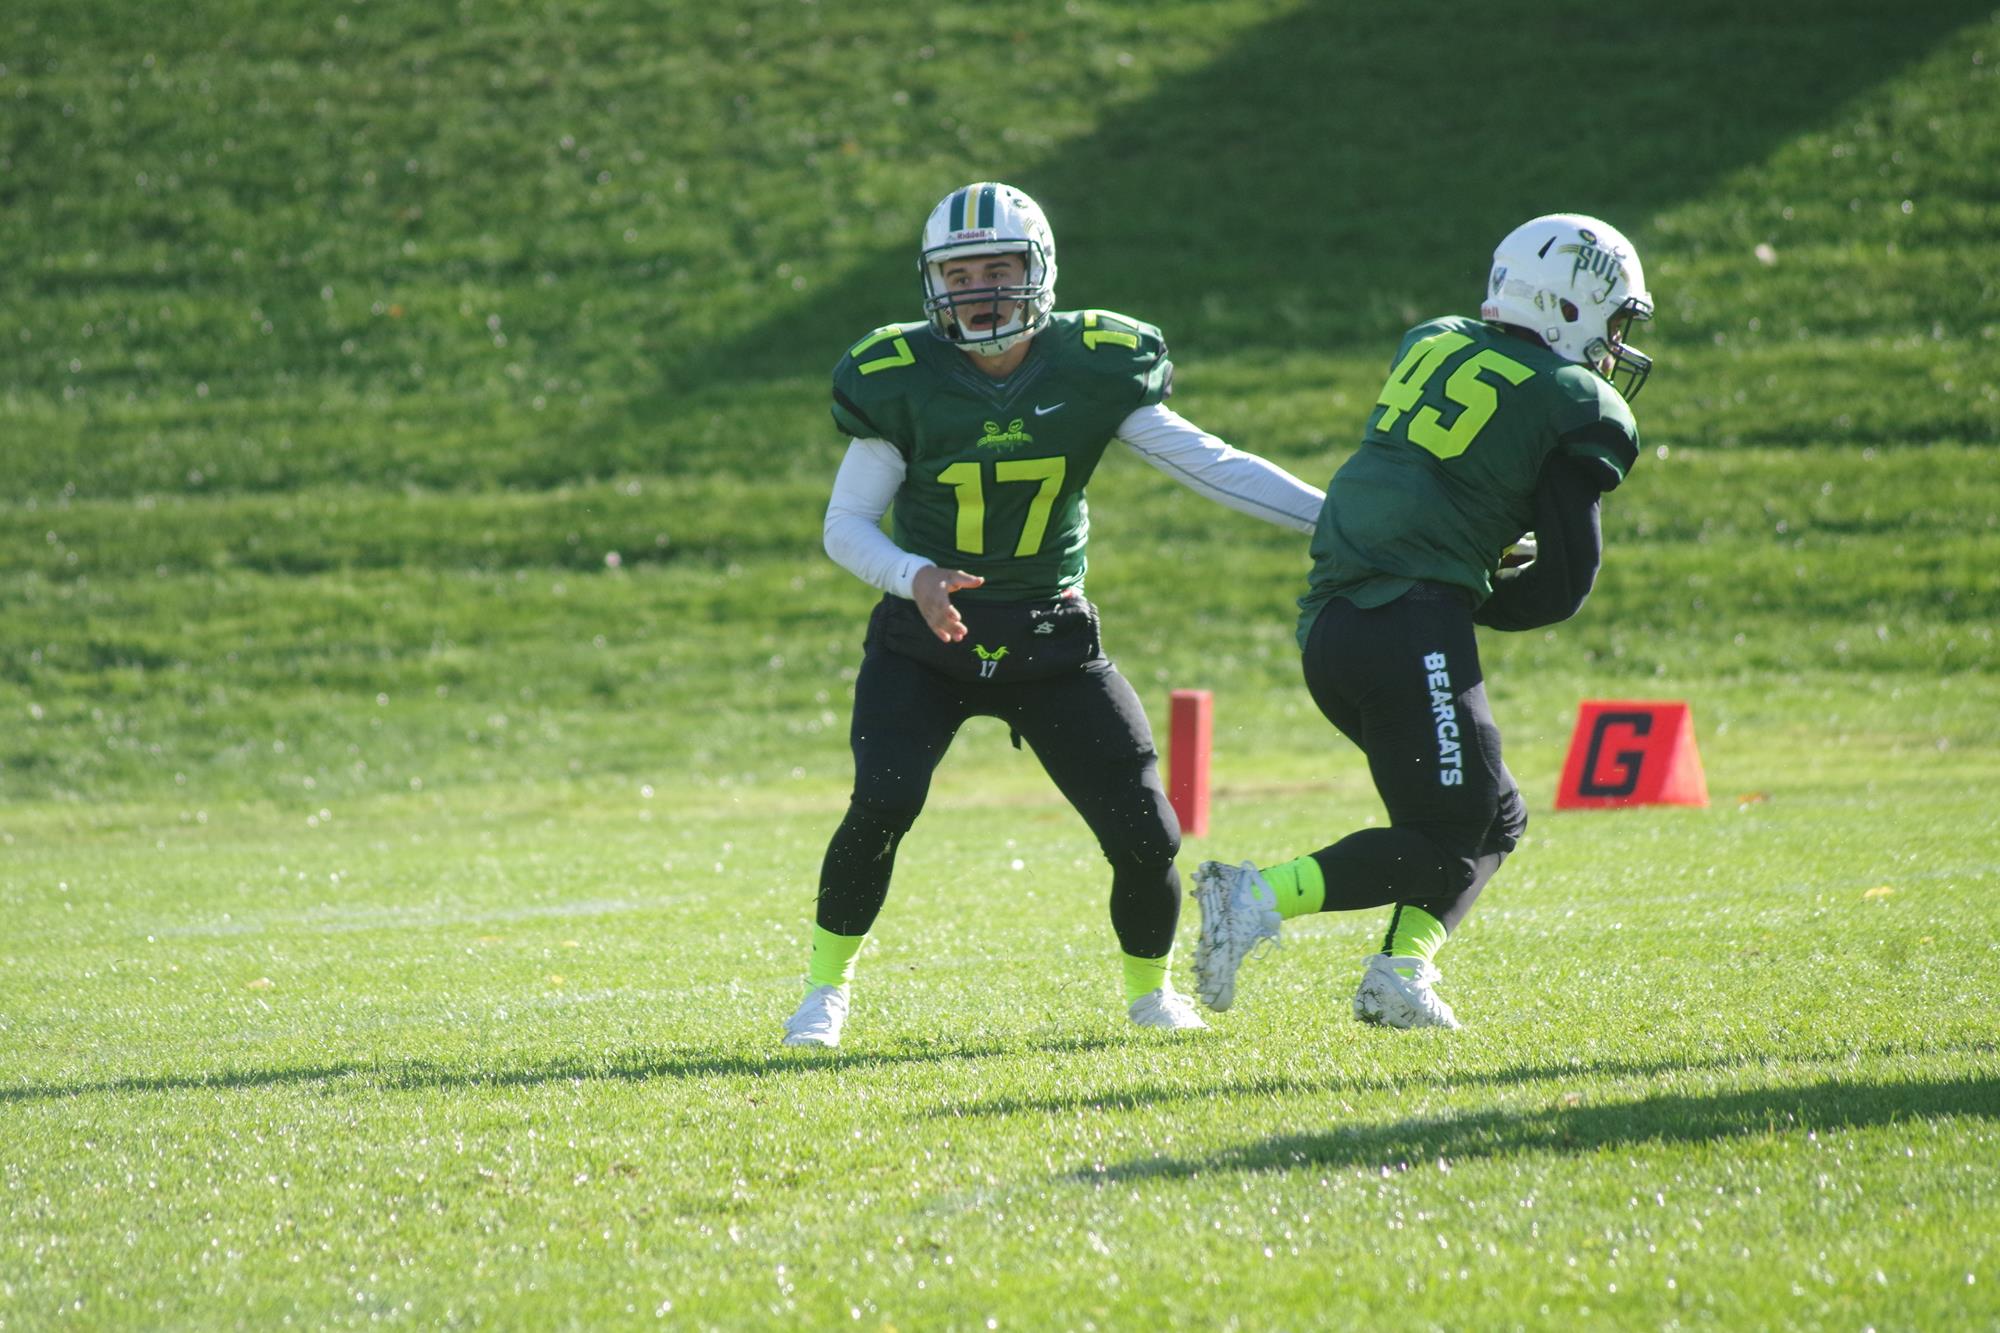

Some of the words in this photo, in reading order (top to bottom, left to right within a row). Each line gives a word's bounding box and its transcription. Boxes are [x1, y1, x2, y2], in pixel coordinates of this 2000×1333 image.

[851, 327, 916, 376] 17
[1083, 309, 1139, 351] 17
[1375, 332, 1537, 461] 45
[937, 456, 1067, 558] 17
[979, 660, 998, 679] 17
[1423, 652, 1464, 787] BEARCATS
[1577, 712, 1654, 797] G
